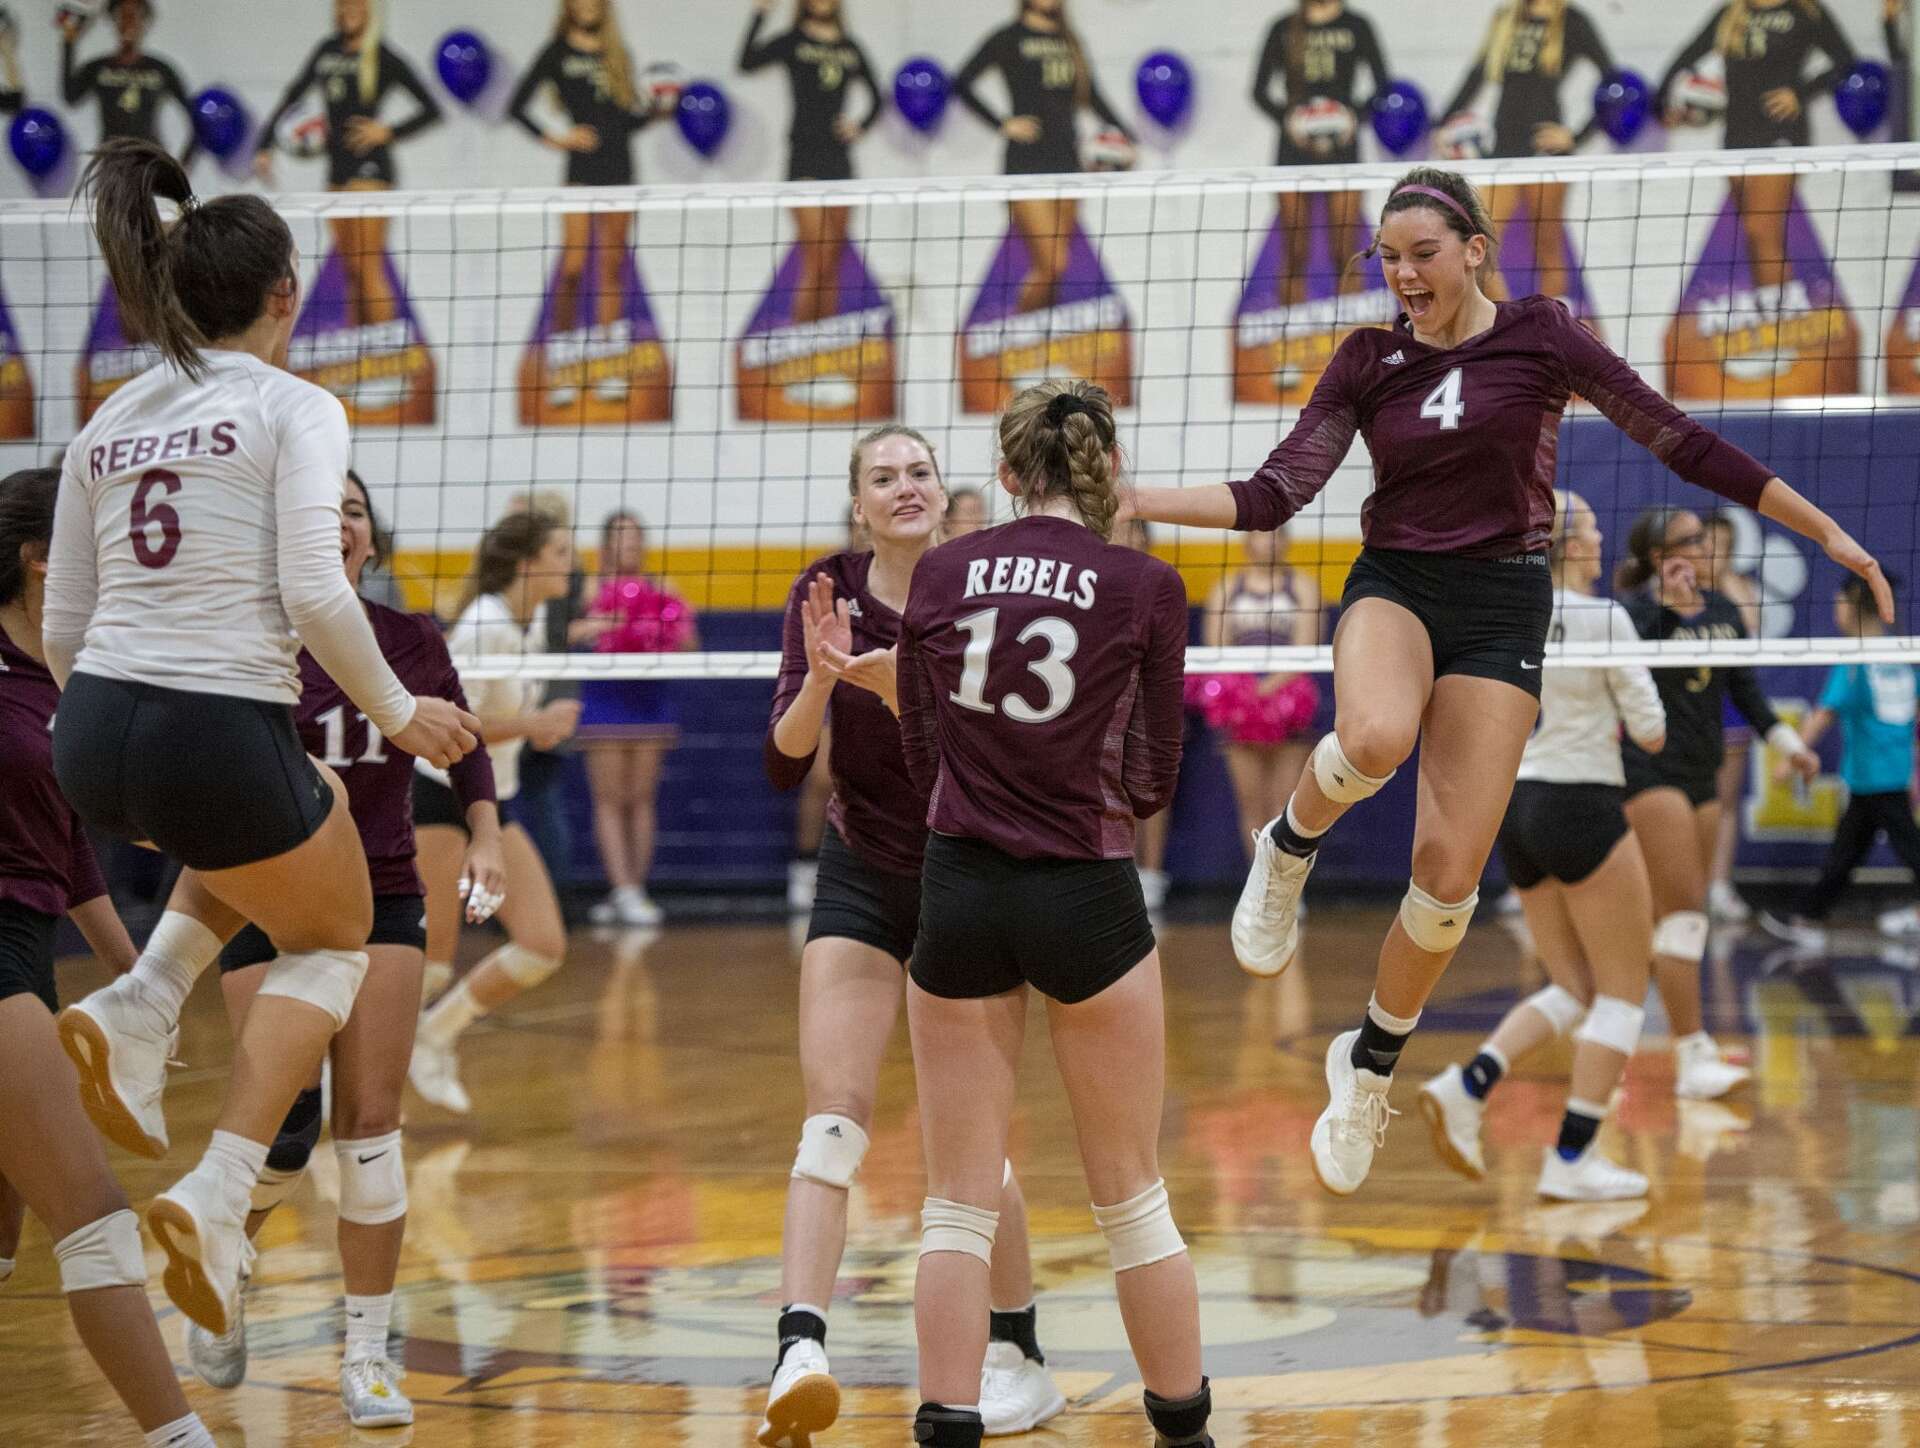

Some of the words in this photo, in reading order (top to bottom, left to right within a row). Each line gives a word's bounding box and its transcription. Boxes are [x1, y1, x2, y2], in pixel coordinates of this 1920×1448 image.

[1420, 367, 1465, 429] 4
[90, 421, 237, 482] REBELS
[130, 468, 182, 569] 6
[963, 556, 1098, 610] REBELS
[1526, 555, 1546, 566] PRO
[949, 607, 1079, 723] 13
[315, 704, 390, 767] 11
